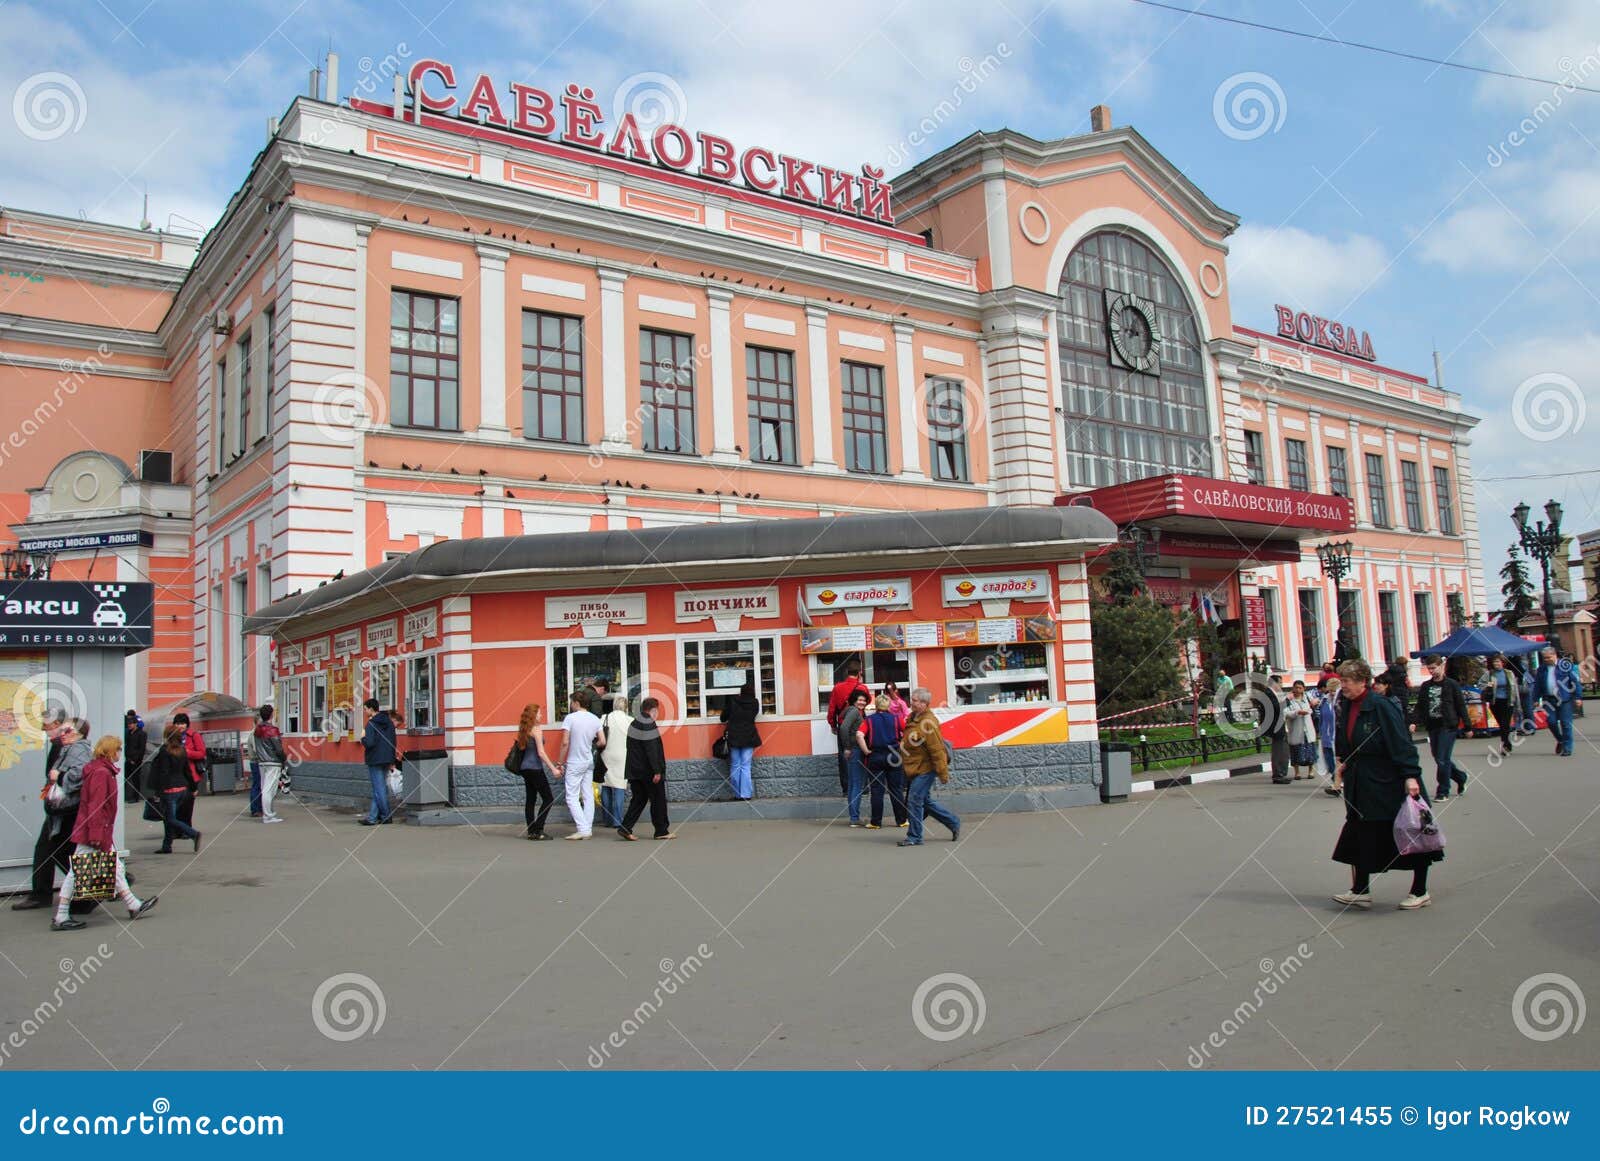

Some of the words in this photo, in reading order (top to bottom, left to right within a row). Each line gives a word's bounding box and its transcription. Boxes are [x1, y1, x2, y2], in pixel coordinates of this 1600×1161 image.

[408, 58, 896, 225] САВЁЛОВСКИЙ
[1275, 304, 1376, 362] ВОКЗАЛ
[1193, 488, 1293, 514] САВЁЛОВСКИЙ
[1297, 501, 1342, 521] ВОКЗАЛ
[65, 536, 101, 547] МОСКВА
[108, 533, 138, 544] ЛОБНЯ
[684, 596, 768, 612] ПОНЧИКИ
[22, 635, 126, 643] ПЕРЕВОЗЧИК
